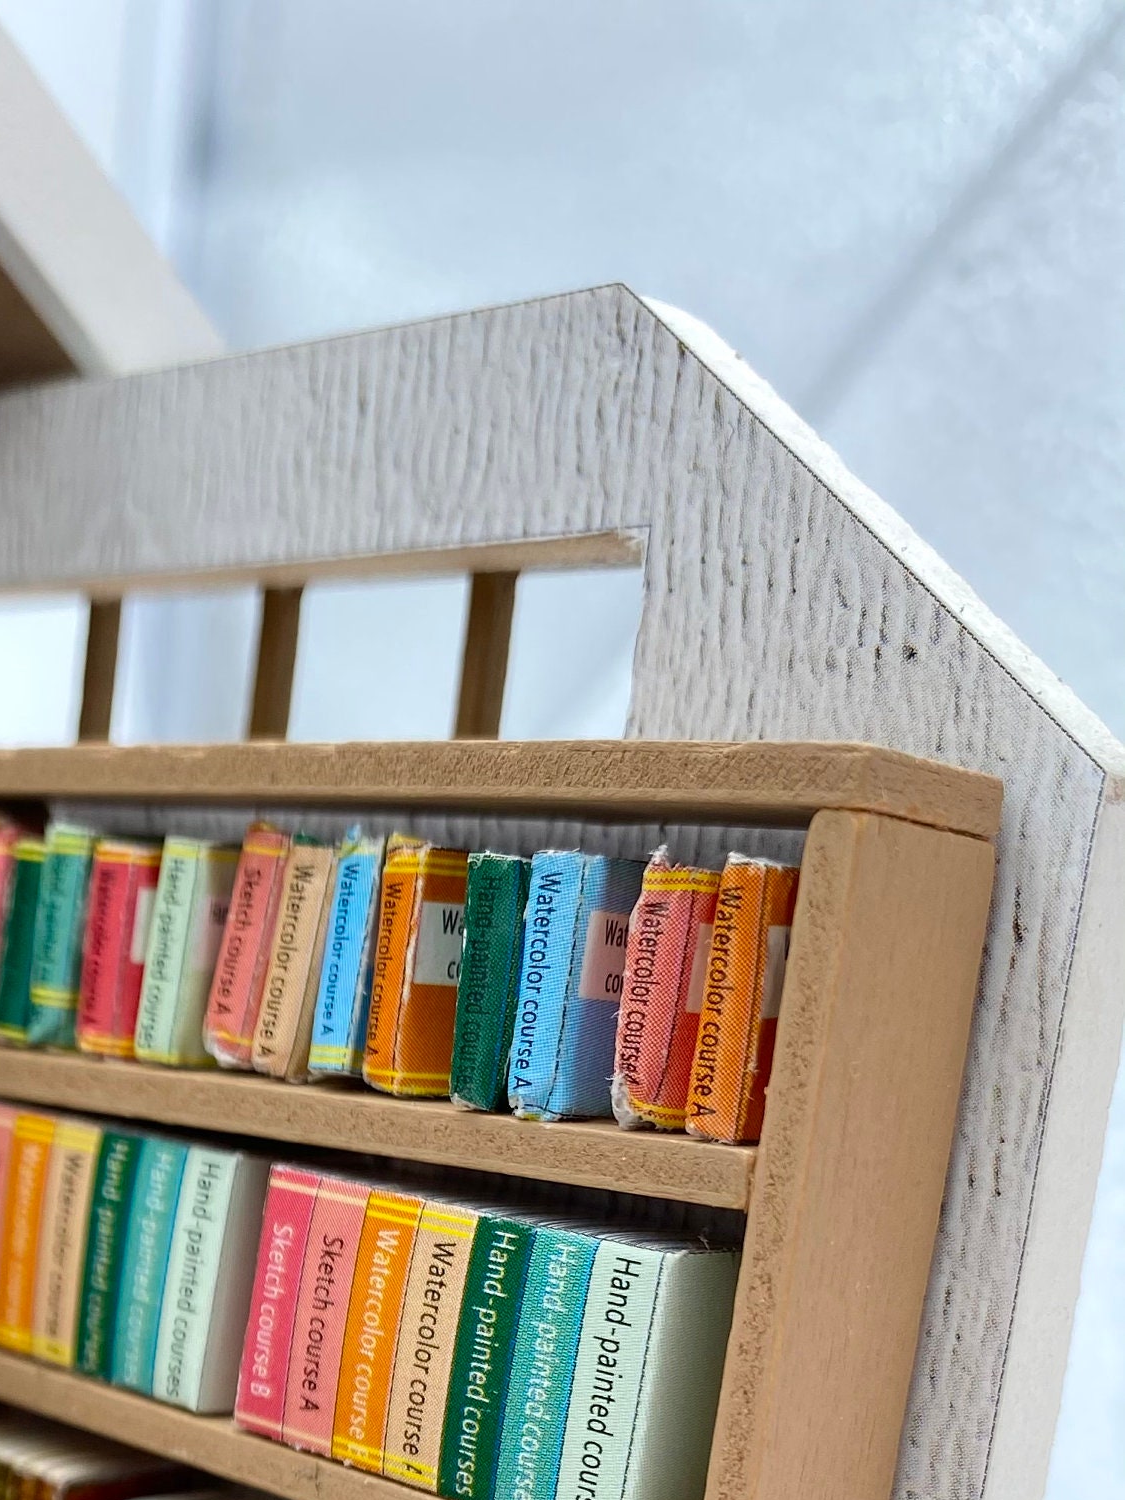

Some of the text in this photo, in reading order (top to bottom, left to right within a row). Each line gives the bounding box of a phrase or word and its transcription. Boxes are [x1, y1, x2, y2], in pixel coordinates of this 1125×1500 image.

[151, 858, 186, 981] Hand-painted
[212, 866, 262, 1016] Sketch course A
[257, 863, 315, 1057] Watercolor course A
[320, 863, 360, 1036] Watercolor course A
[365, 881, 404, 1057] Watercolor course A
[512, 872, 563, 1090] Watercolor course A
[631, 901, 670, 1006] Watercolor
[690, 886, 744, 1117] Watercolor course A
[166, 1161, 221, 1398] Hand-painted courses
[250, 1222, 294, 1398] Sketch course B
[299, 1235, 344, 1412] Sketch course A
[360, 1228, 401, 1358] Watercolor
[415, 1241, 457, 1373] Watercolor
[455, 1230, 520, 1498] Hand-painted courses
[525, 1243, 575, 1420] Hand-painted
[587, 1257, 642, 1437] Hand-painted
[348, 1363, 374, 1441] course
[402, 1378, 427, 1456] course
